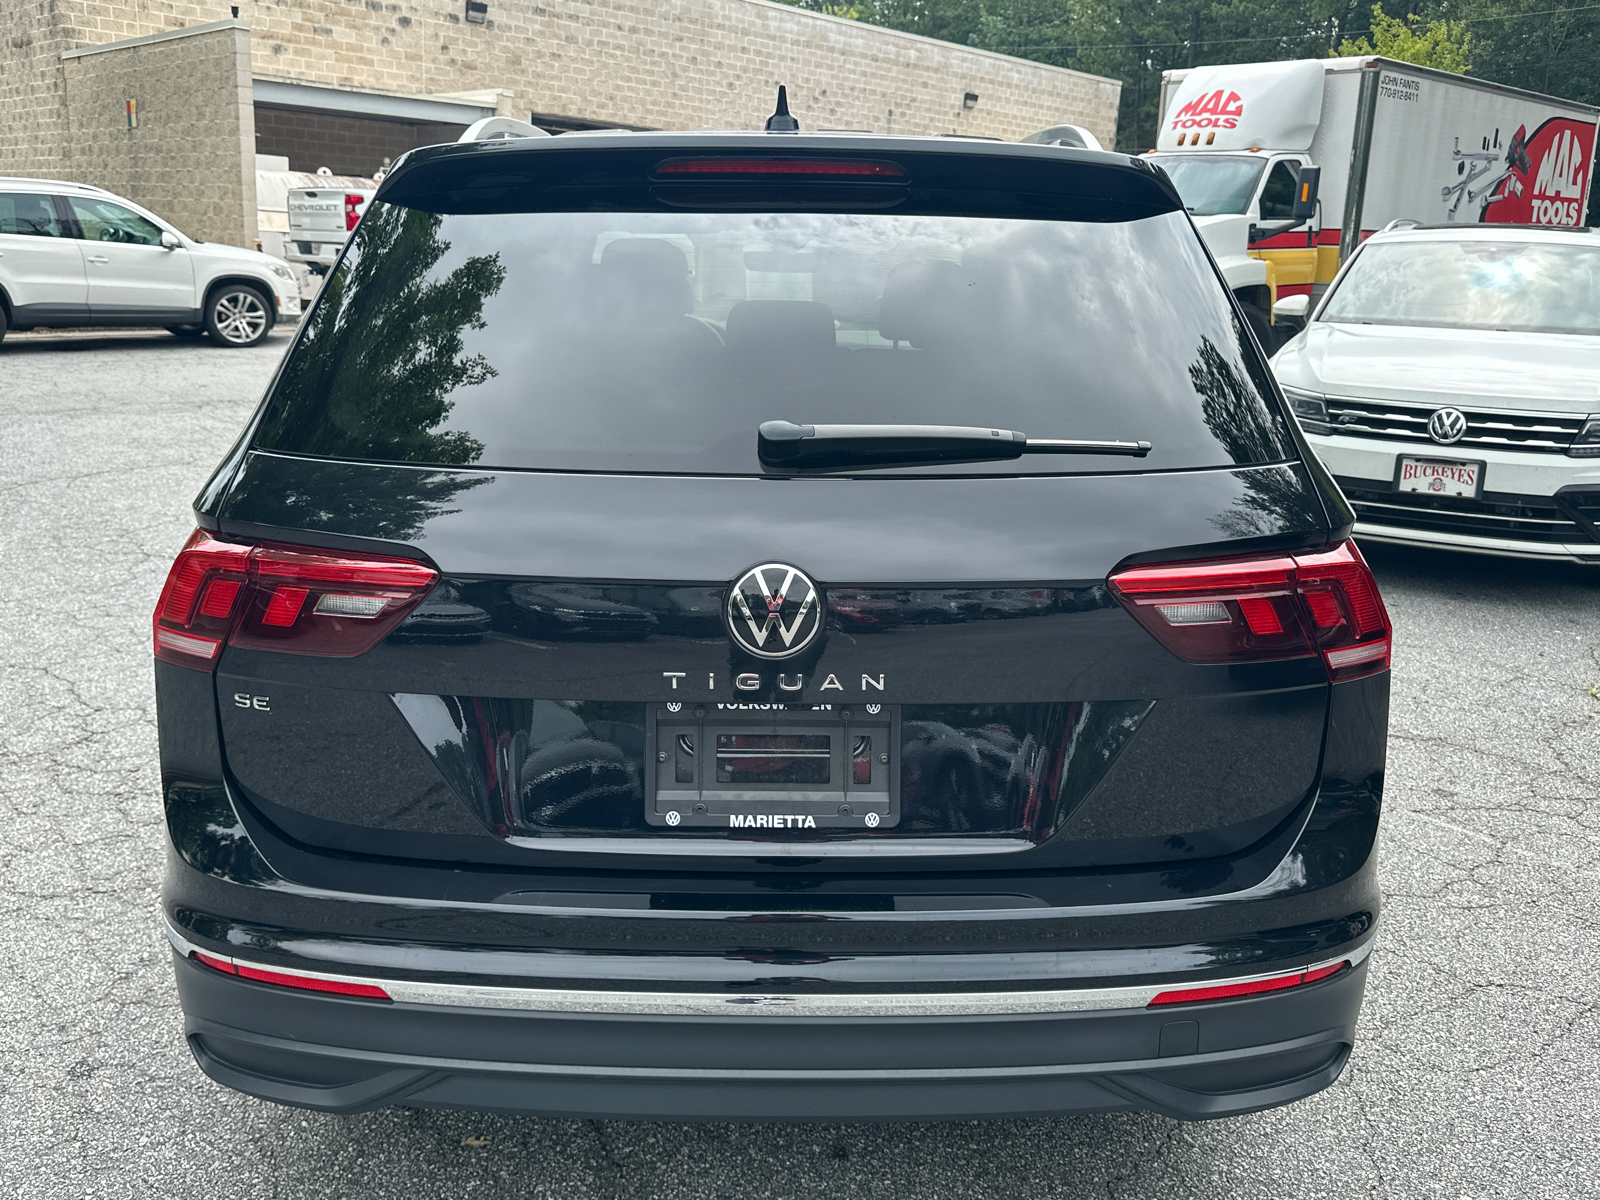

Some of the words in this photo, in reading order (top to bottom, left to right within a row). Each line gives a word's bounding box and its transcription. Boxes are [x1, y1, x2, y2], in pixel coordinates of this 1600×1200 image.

[1381, 74, 1398, 87] JOHN
[1399, 78, 1420, 91] FANTIS
[1380, 86, 1419, 102] 770-912-8411
[1175, 89, 1243, 119] MAC
[1171, 117, 1238, 130] TOOLS
[1533, 129, 1583, 199] MAC
[1531, 199, 1579, 226] TOOLS
[1403, 464, 1475, 486] BUCKEYES
[234, 692, 271, 711] SE
[729, 814, 817, 829] MARIETTA
